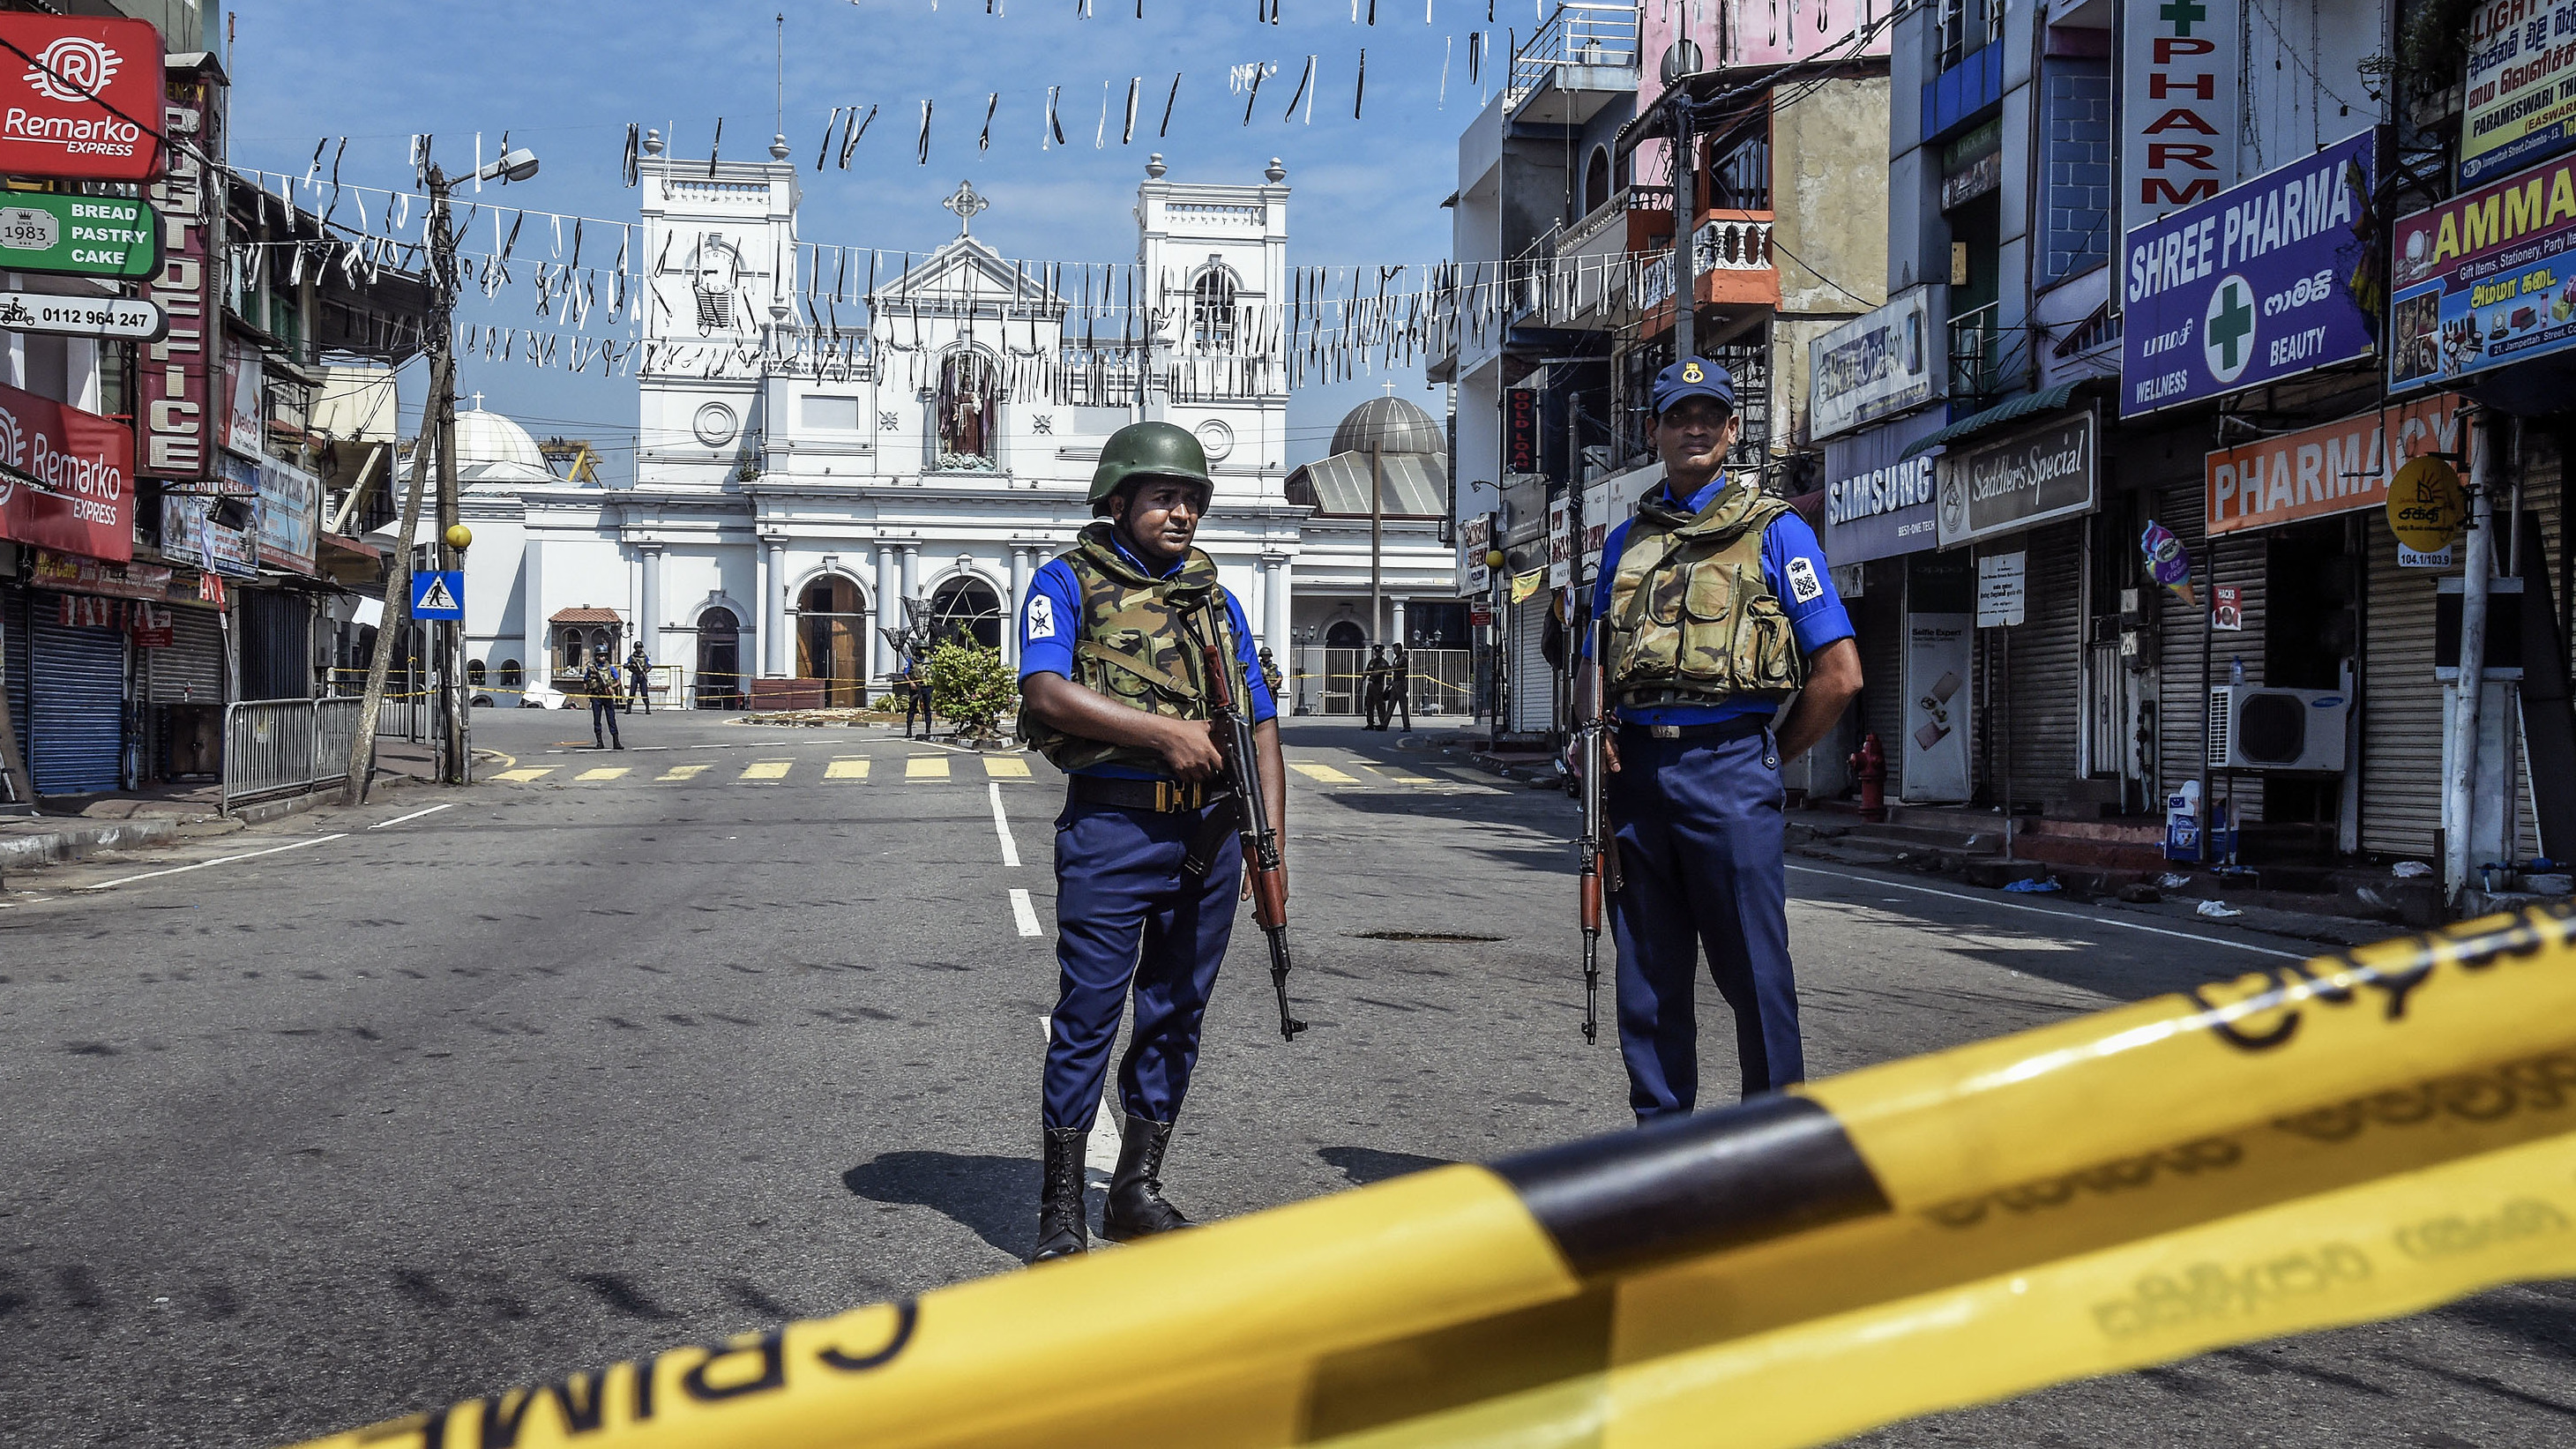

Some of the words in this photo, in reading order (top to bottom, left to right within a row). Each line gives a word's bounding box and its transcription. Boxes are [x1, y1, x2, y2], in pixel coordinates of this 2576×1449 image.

[5, 108, 140, 143] Remarko
[2474, 86, 2554, 138] PARAMESWARI
[66, 141, 134, 157] EXPRESS
[71, 204, 138, 221] BREAD
[2434, 168, 2576, 265] AMMA
[4, 226, 46, 241] 1983
[71, 227, 147, 244] PASTRY
[2129, 215, 2217, 302] SHREE
[2221, 159, 2351, 270] PHARMA
[71, 249, 125, 265] CAKE
[2460, 265, 2474, 281] Gift
[2475, 258, 2498, 276] Items,
[2500, 243, 2542, 269] Stationery,
[2543, 239, 2565, 256] Party
[42, 308, 81, 324] 0112
[86, 310, 115, 325] 964
[119, 313, 148, 328] 247
[2269, 326, 2326, 367] BEAUTY
[2505, 334, 2541, 351] Jampettah
[149, 258, 200, 469] OFFICE
[2137, 370, 2187, 404] WELLNESS
[234, 408, 258, 441] Dialog
[1513, 392, 1530, 429] GOLD
[33, 432, 121, 501] Remarko
[1973, 459, 2027, 503] Saddler's
[2027, 429, 2085, 505] Special
[2215, 411, 2458, 521] PHARMACY
[1829, 456, 1935, 526] SAMSUNG
[73, 498, 116, 526] EXPRESS
[1898, 523, 1922, 537] BEST-ONE
[1923, 519, 1935, 532] TECH
[2169, 558, 2182, 571] Ice
[2401, 554, 2450, 565] 104.1/103.9
[2218, 589, 2235, 600] HACKS
